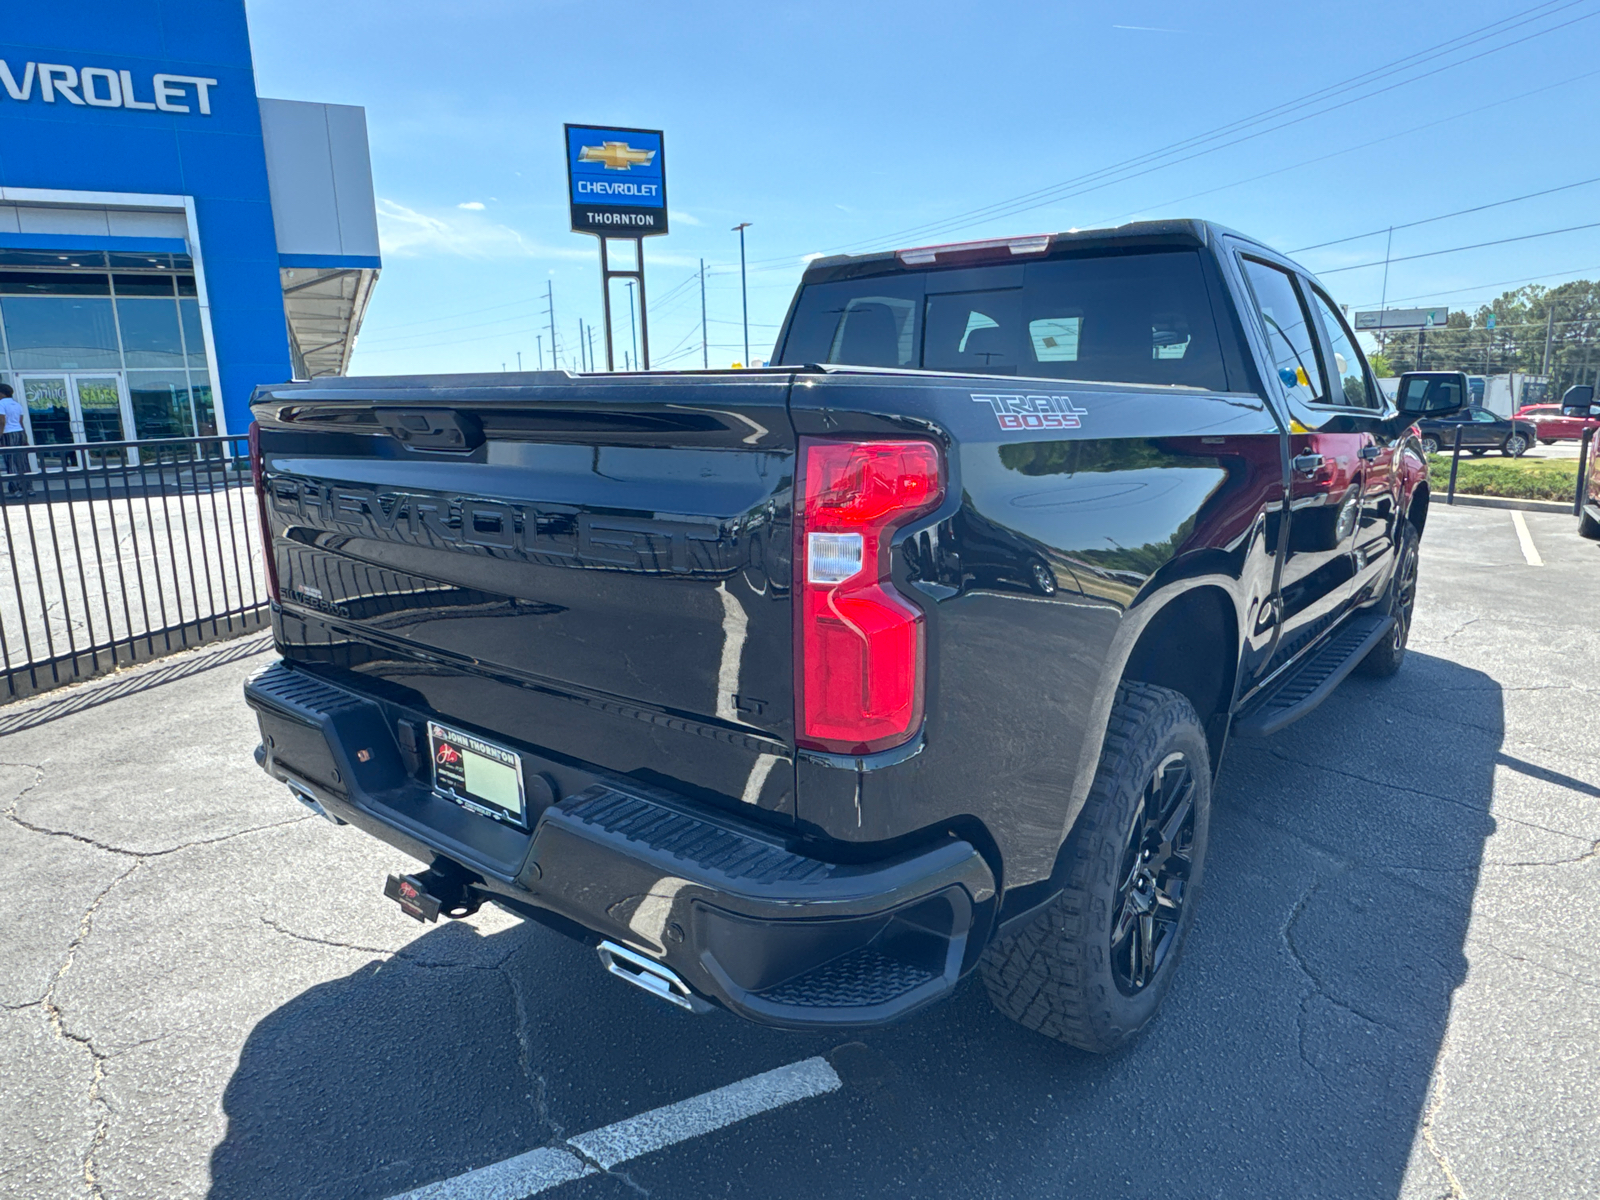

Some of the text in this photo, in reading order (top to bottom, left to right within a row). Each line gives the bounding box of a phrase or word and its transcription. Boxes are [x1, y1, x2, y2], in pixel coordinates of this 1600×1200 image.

[577, 180, 658, 197] CHEVROLET
[586, 212, 654, 226] THORNTON
[969, 393, 1089, 415] TRAIL
[996, 414, 1082, 431] BOSS
[270, 479, 721, 574] CHEVROLET
[446, 731, 515, 765] JOHN THORNTON
